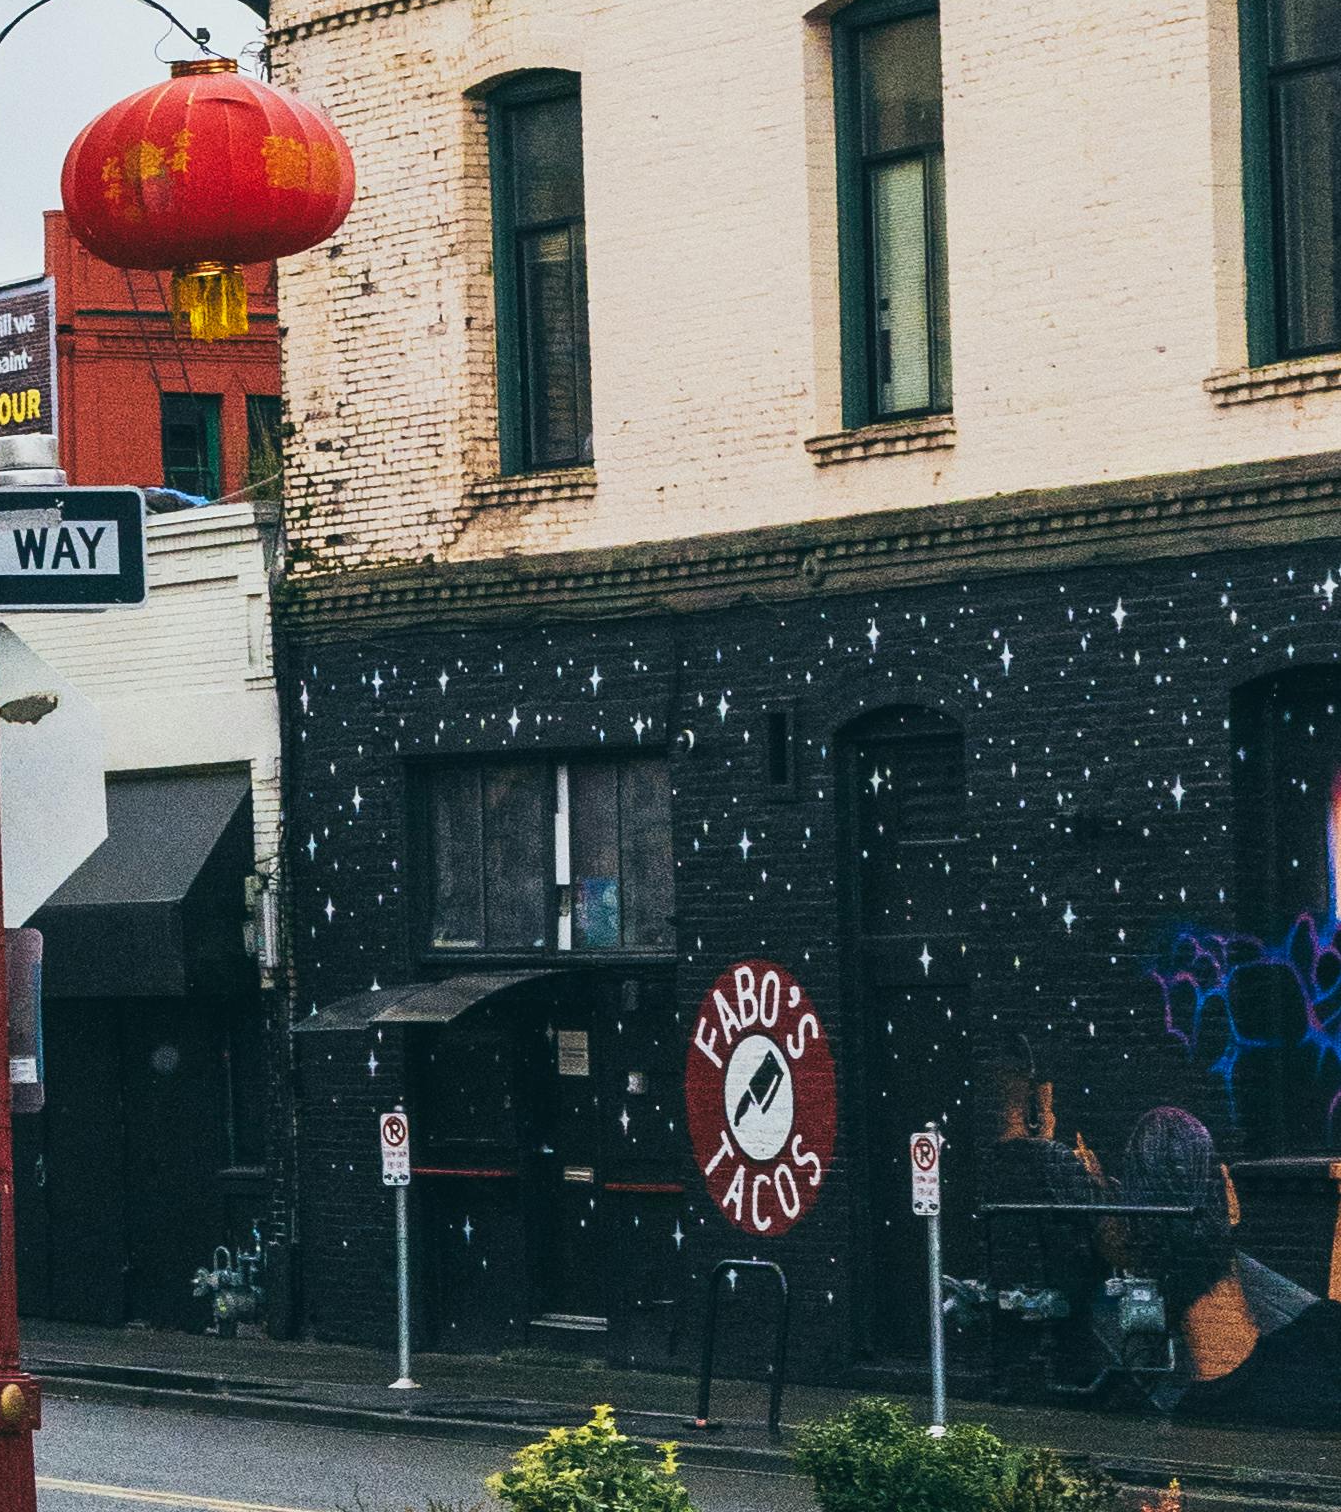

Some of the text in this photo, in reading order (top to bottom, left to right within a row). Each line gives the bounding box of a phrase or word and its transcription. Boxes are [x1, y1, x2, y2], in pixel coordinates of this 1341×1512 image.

[13, 313, 36, 334] we
[13, 527, 107, 570] WAY
[695, 966, 819, 1068] FABO'S
[704, 1130, 822, 1231] TACOS
